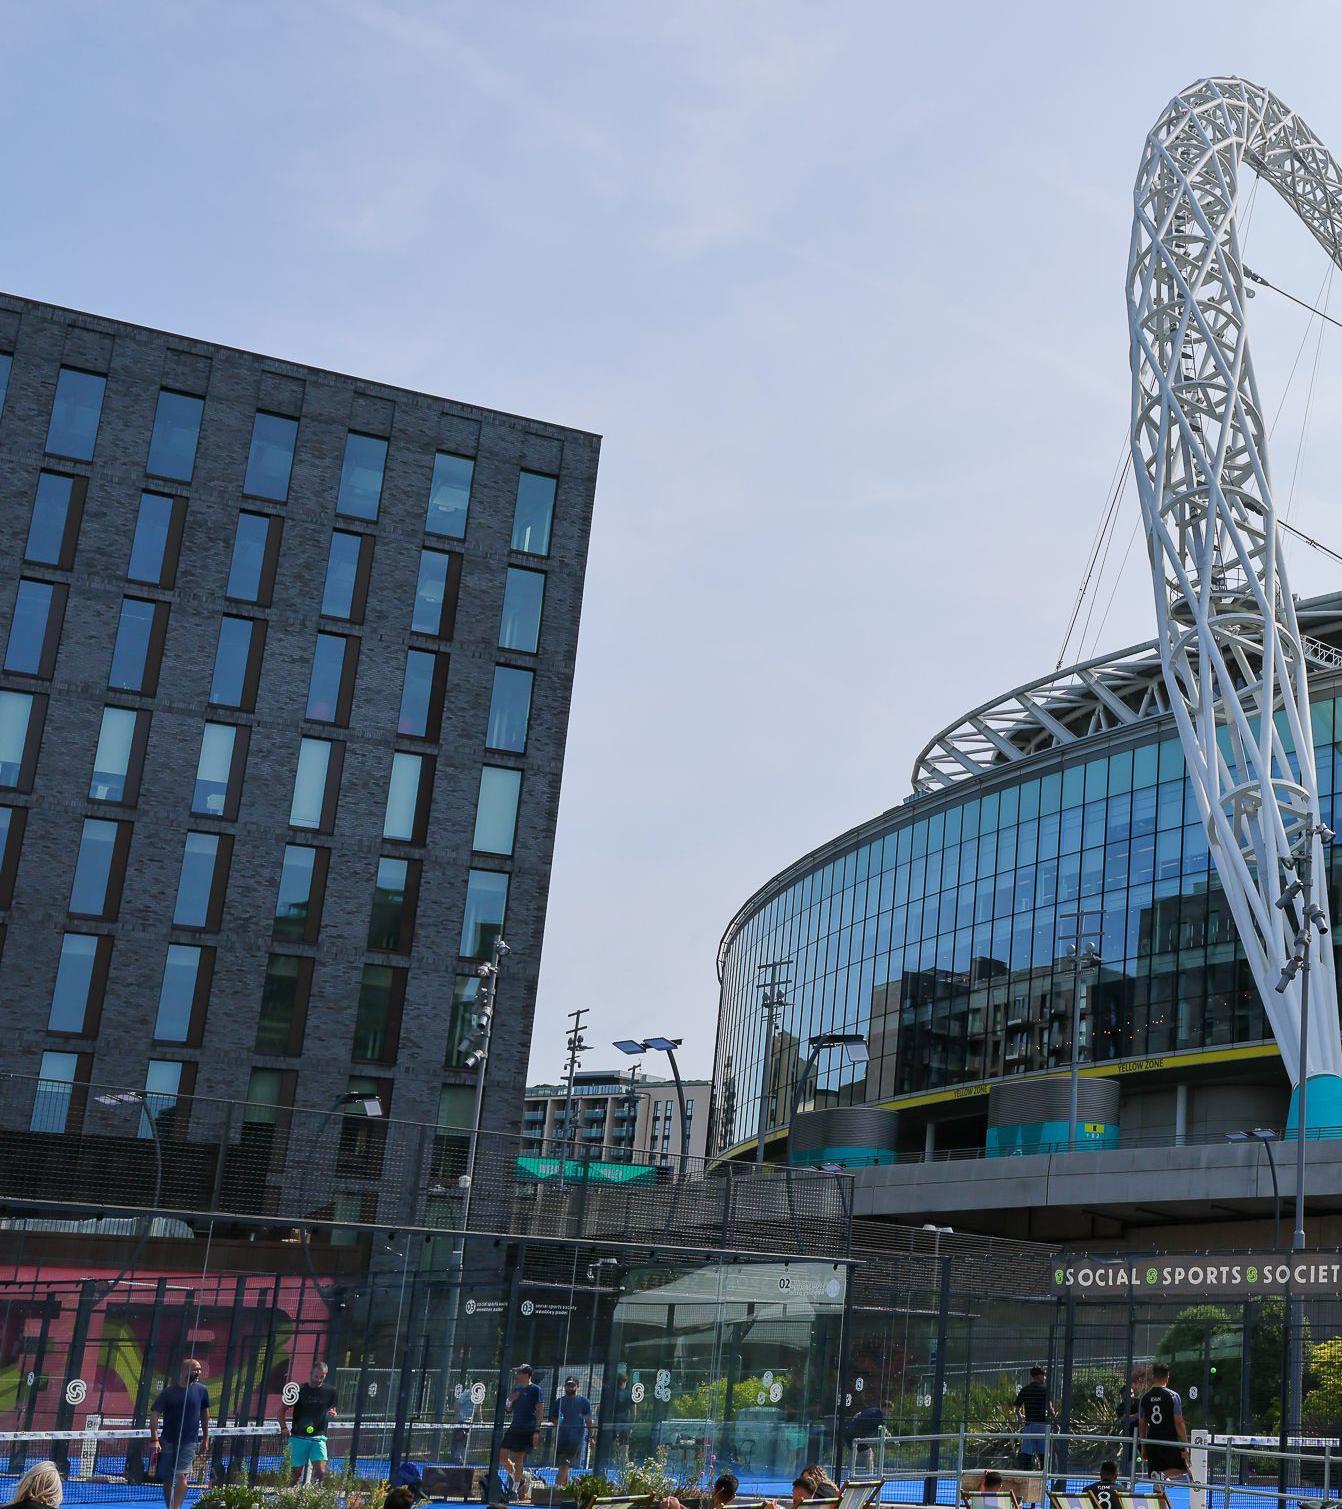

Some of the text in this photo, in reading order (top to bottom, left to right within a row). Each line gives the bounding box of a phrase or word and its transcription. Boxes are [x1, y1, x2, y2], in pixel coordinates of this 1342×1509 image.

[1118, 1059, 1164, 1072] YELLOW ZONE
[779, 1278, 791, 1289] 02
[1066, 1268, 1141, 1287] SOCIAL
[1162, 1266, 1241, 1285] SPORTS
[1151, 1405, 1163, 1425] 8
